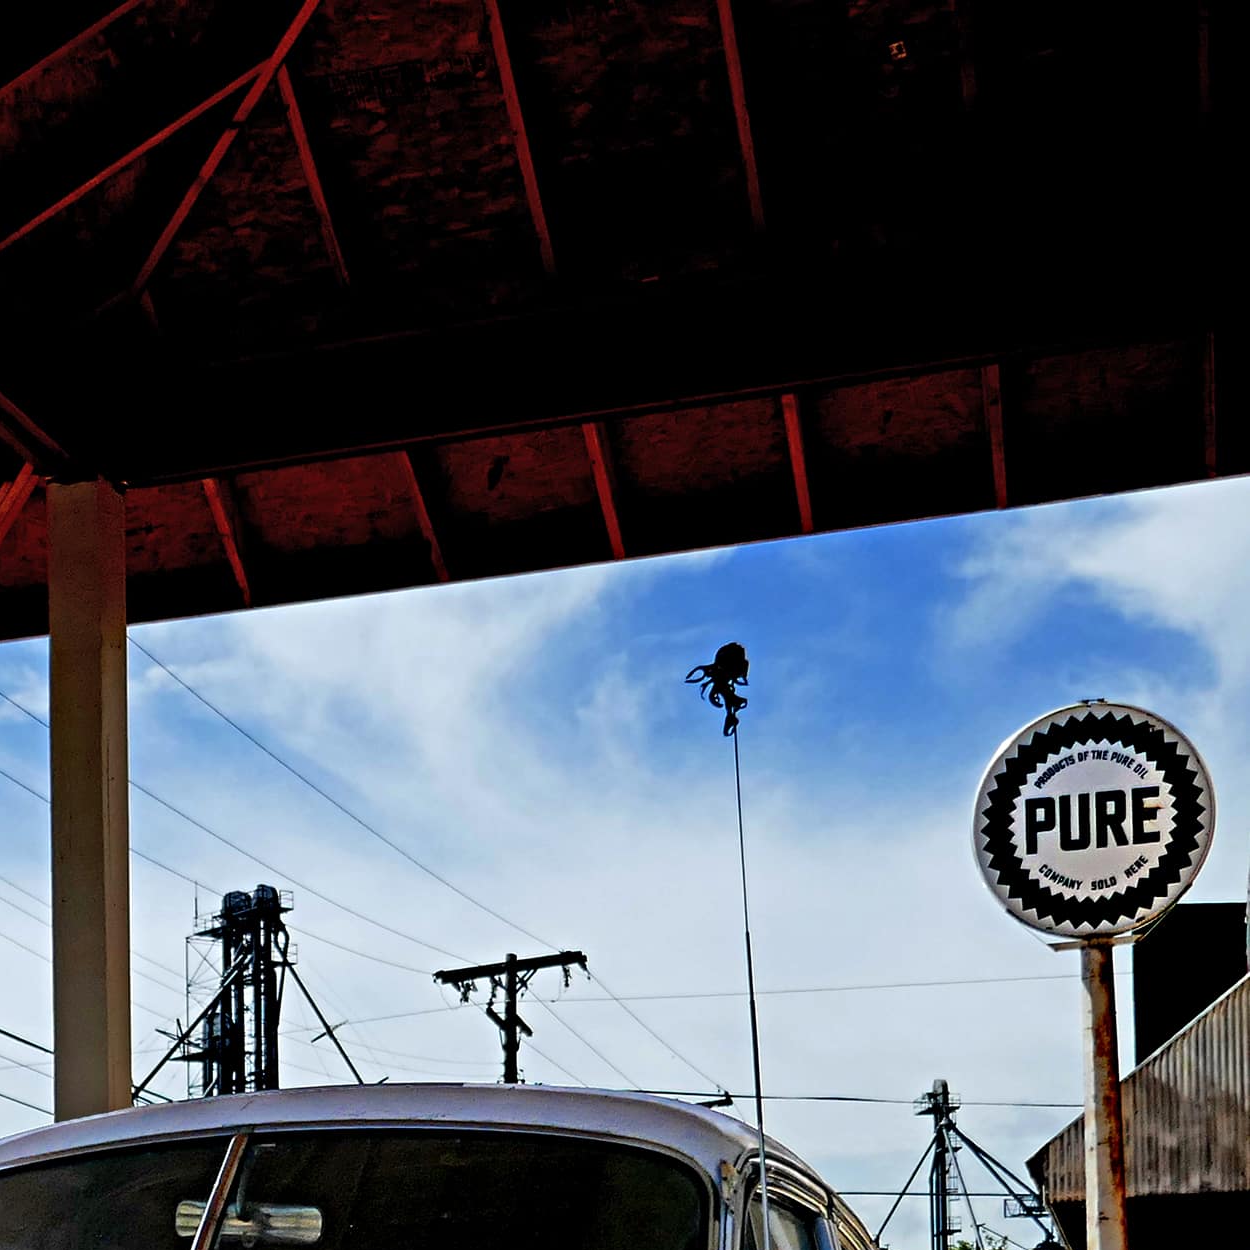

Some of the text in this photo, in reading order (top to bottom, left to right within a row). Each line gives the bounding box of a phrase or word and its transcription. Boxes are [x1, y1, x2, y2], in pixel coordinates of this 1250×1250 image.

[1034, 750, 1149, 789] PRODUCTS OF THE PURE OIL
[1025, 786, 1161, 855] PURE
[1039, 855, 1148, 890] COMPANY SOLD HERE
